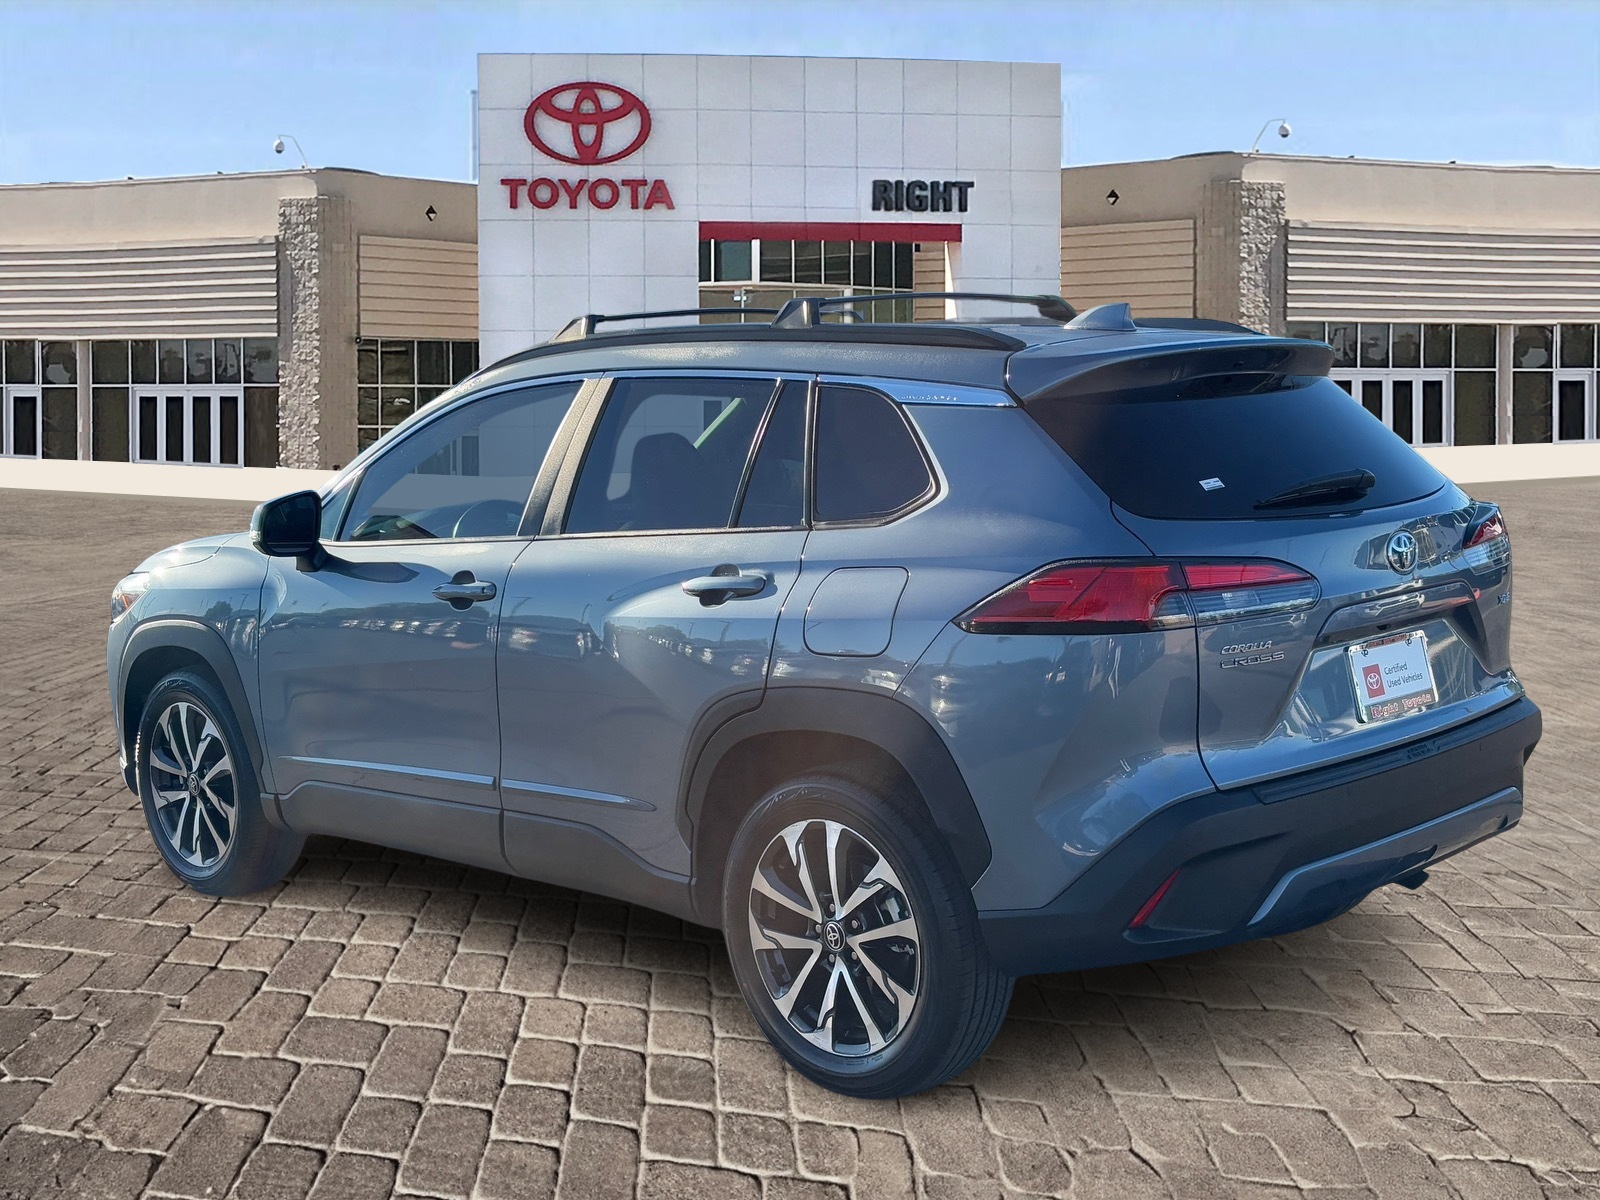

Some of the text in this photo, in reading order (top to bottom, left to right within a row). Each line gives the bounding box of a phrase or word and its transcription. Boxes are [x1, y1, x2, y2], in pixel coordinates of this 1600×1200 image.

[500, 178, 675, 210] TOYOTA
[871, 178, 975, 213] RIGHT
[1221, 640, 1273, 655] COROLLA
[1221, 651, 1285, 669] CROSS
[1383, 661, 1408, 675] Certified
[1386, 671, 1423, 688] Used Vehicles
[1402, 693, 1432, 710] Toyota
